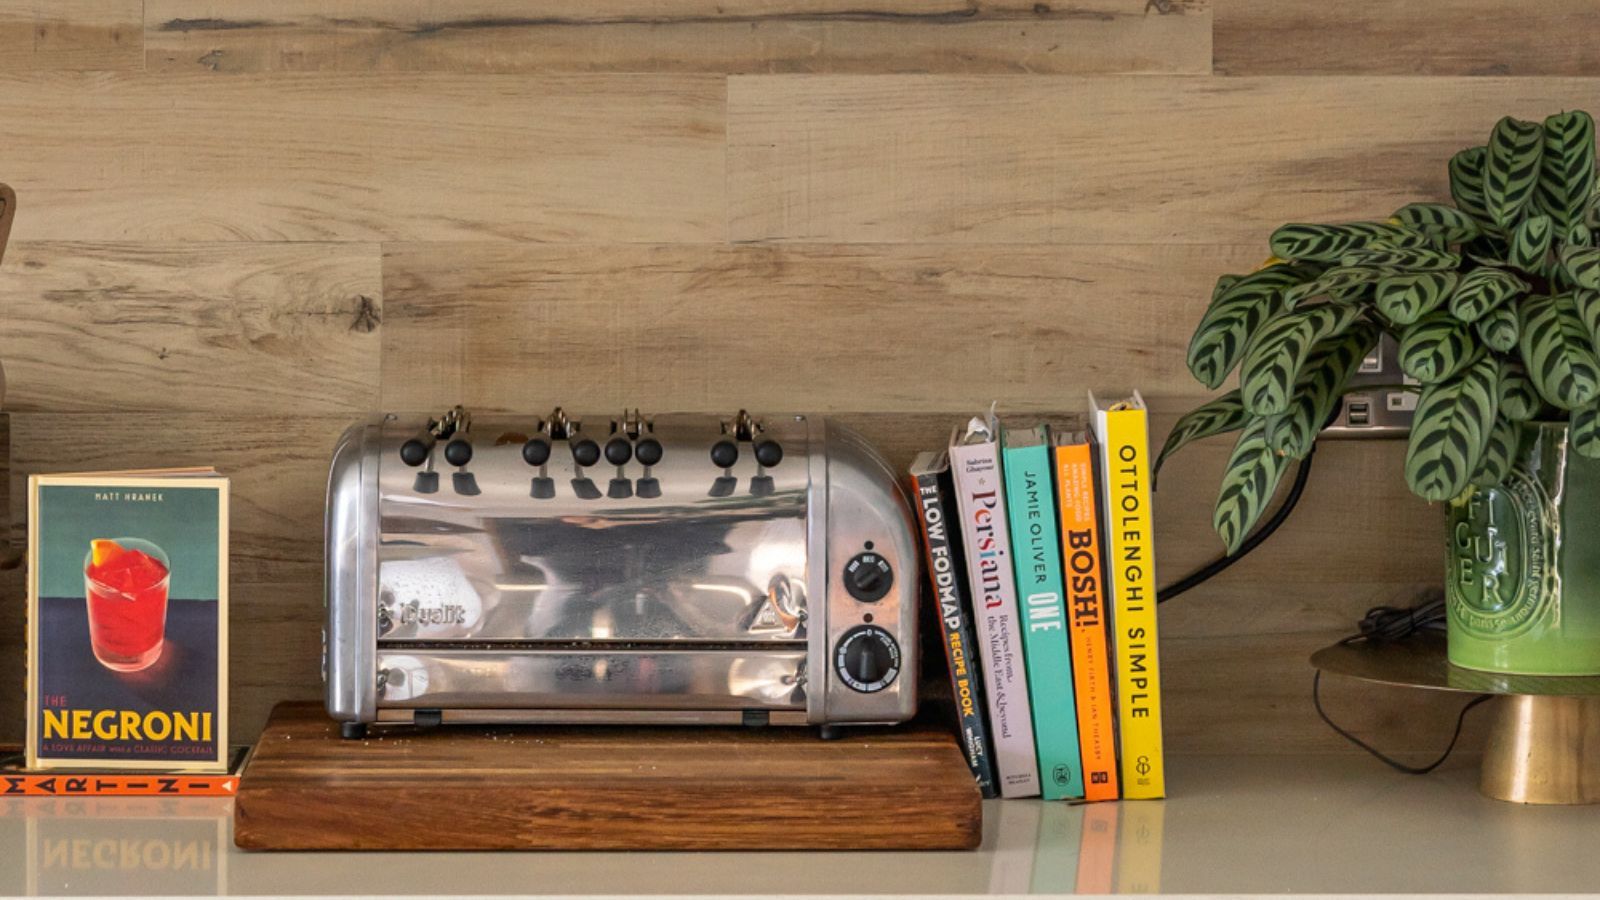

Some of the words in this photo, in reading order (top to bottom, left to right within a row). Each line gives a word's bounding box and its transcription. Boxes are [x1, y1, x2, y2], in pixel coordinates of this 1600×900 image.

[95, 492, 119, 501] MATT
[124, 493, 163, 502] HRANEK
[920, 485, 937, 495] THE
[1024, 471, 1040, 519] JAMIE
[923, 498, 945, 540] LOW
[1119, 445, 1144, 611] OTTOLENGHI
[972, 490, 1003, 609] Persiana
[1030, 525, 1047, 583] OLIVER
[932, 546, 960, 629] FODMAP
[1068, 529, 1098, 627] BOSH!
[987, 615, 997, 631] the
[1027, 592, 1062, 632] ONE
[990, 634, 1002, 667] Middle
[999, 614, 1011, 653] Recipes
[949, 632, 967, 676] RECIPE
[1128, 627, 1149, 718] SIMPLE
[958, 679, 975, 717] BOOK
[994, 669, 1004, 690] East
[44, 695, 66, 706] THE
[43, 709, 212, 741] NEGRONI
[997, 702, 1012, 739] beyond
[4, 778, 210, 793] MARTINI
